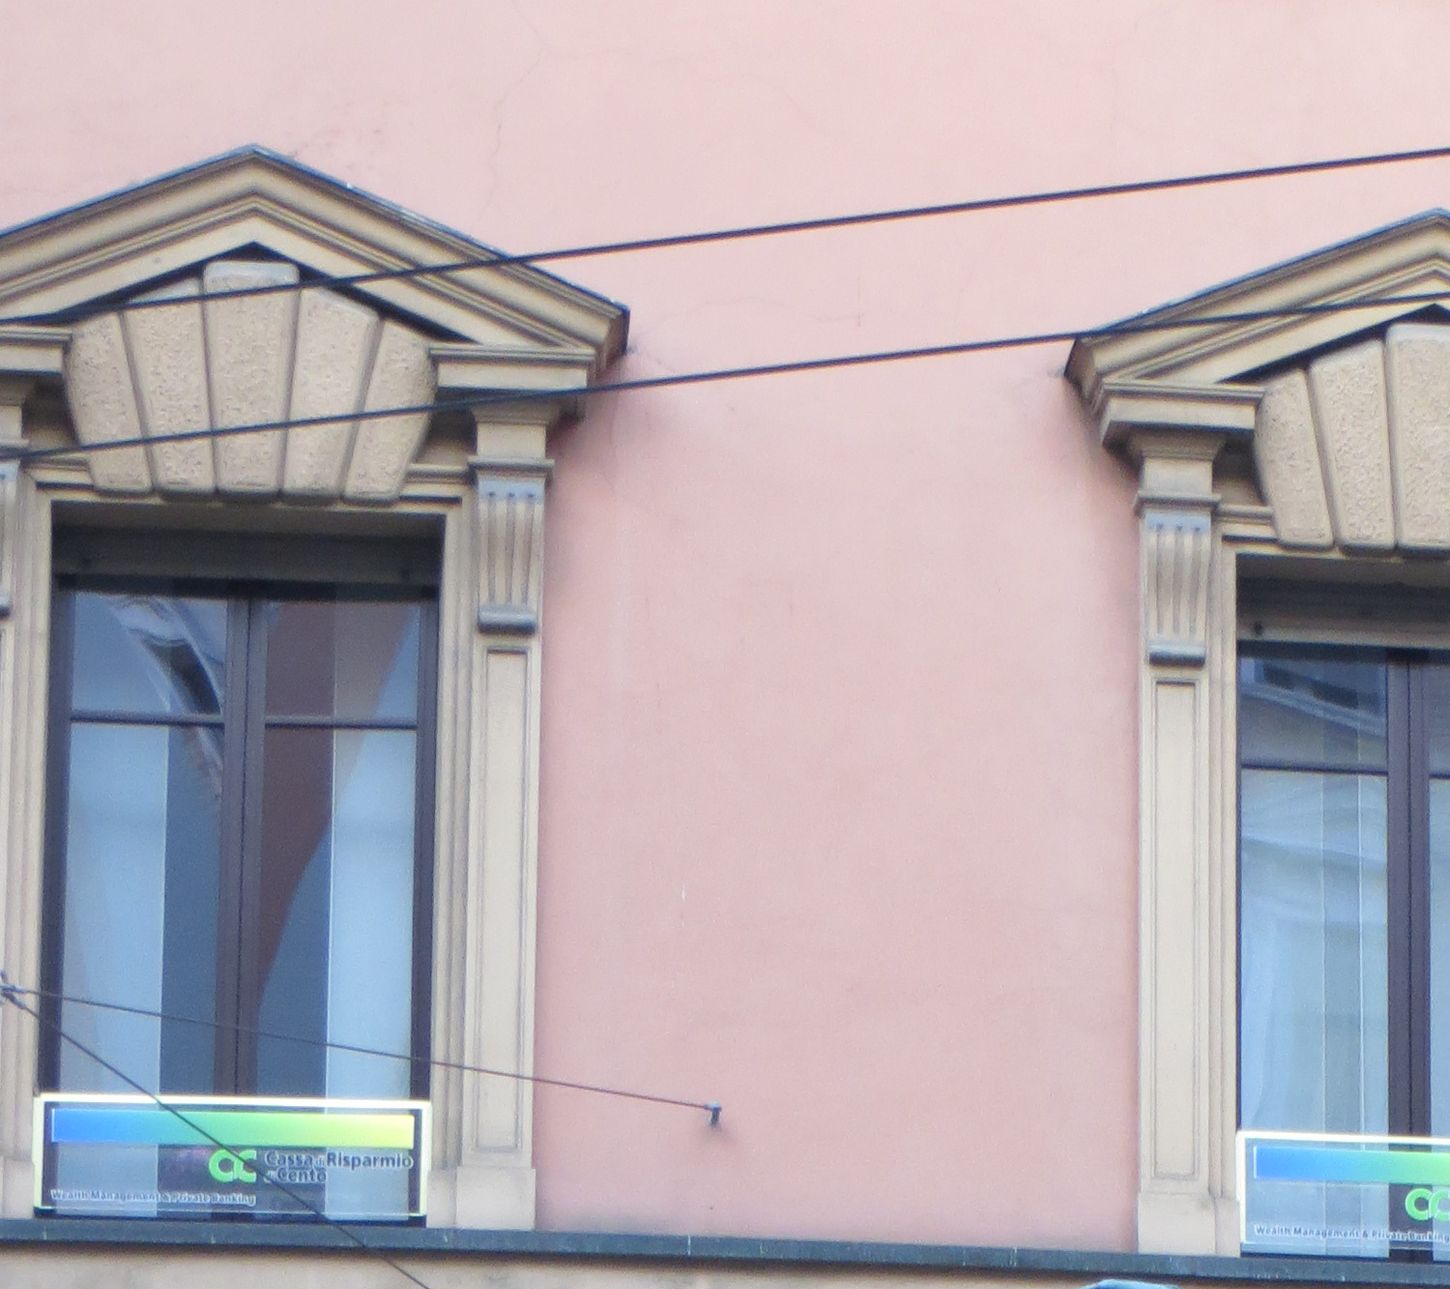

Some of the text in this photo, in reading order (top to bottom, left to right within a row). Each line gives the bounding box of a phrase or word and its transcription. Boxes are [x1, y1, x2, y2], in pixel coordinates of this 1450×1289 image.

[264, 1150, 313, 1168] Cassa
[326, 1151, 414, 1170] Risparmio
[277, 1167, 327, 1184] Cento
